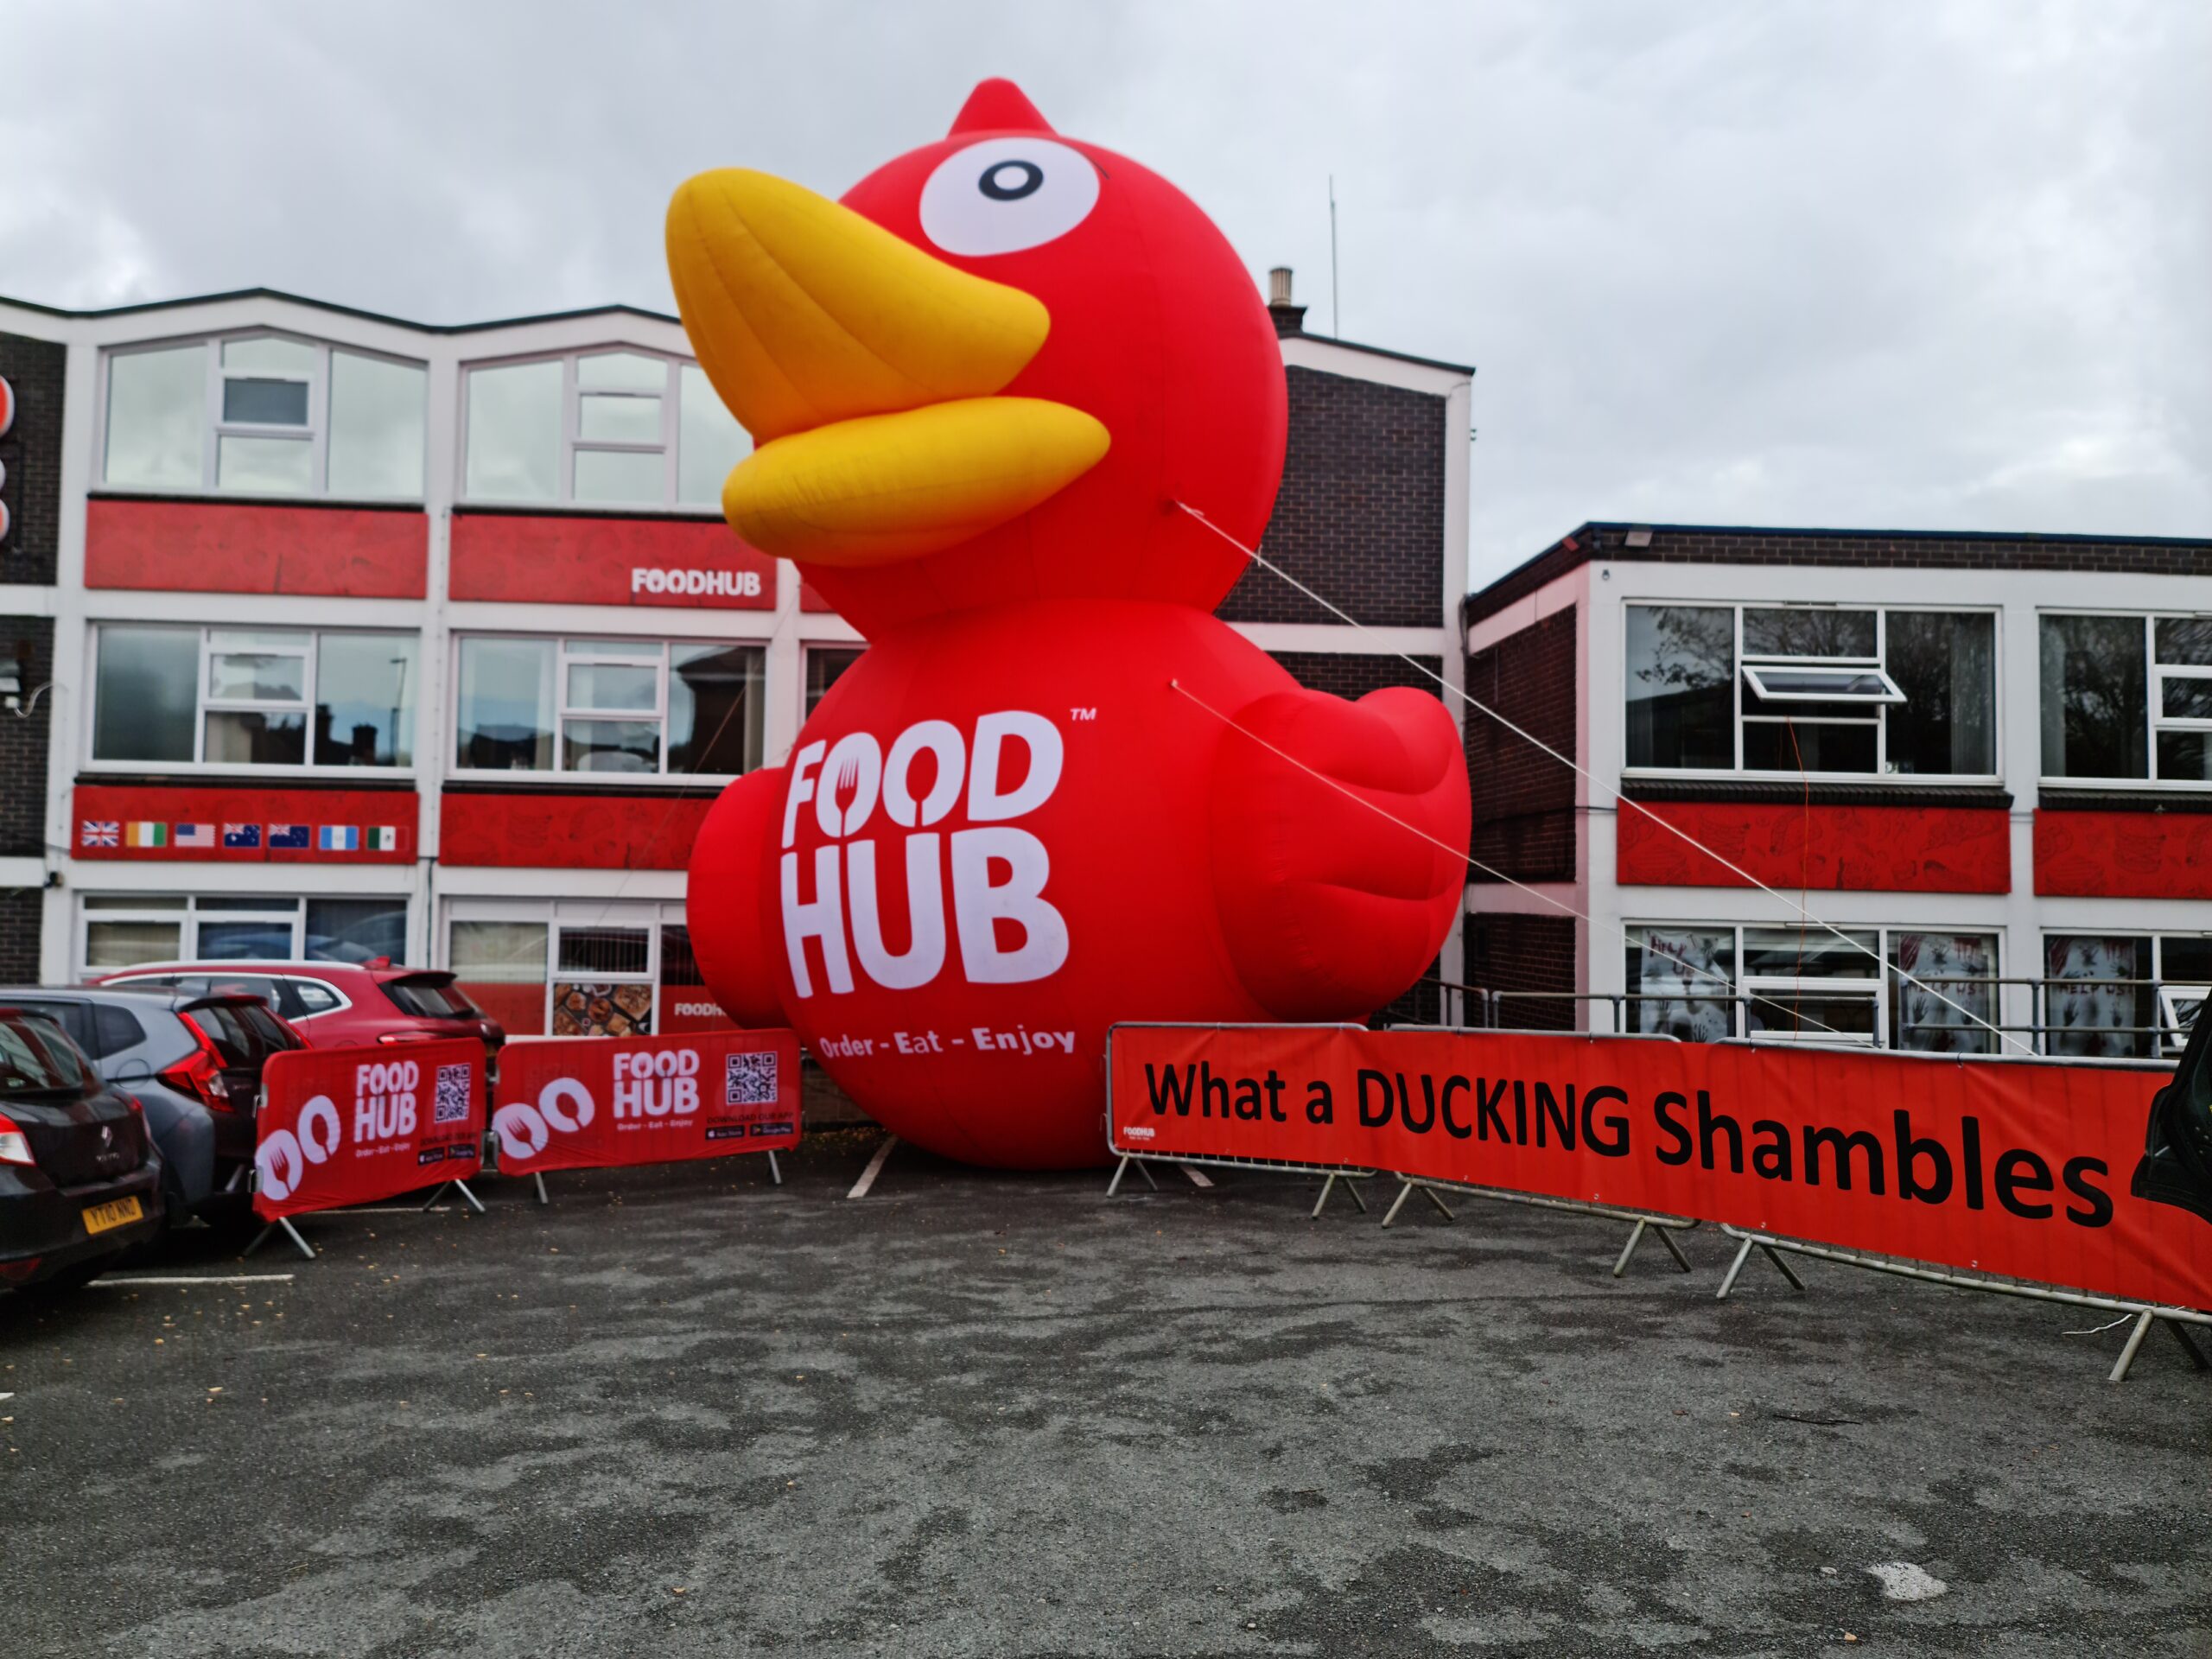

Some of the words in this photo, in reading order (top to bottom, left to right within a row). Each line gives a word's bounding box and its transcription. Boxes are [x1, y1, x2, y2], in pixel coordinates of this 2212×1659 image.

[632, 568, 761, 596] FOODHUB
[781, 709, 1065, 849] FOOD
[780, 826, 1070, 999] HUB
[819, 1033, 874, 1059] Order
[893, 1031, 944, 1054] Eat
[971, 1025, 1076, 1055] Enjoy
[355, 1060, 419, 1097] FOOD
[613, 1049, 700, 1080] FOOD
[353, 1092, 417, 1143] HUB
[613, 1077, 700, 1118] HUB
[1144, 1060, 1287, 1122] What
[1306, 1080, 1334, 1124] a
[1357, 1068, 1630, 1158] DUCKING
[1653, 1089, 2115, 1228] Shambles
